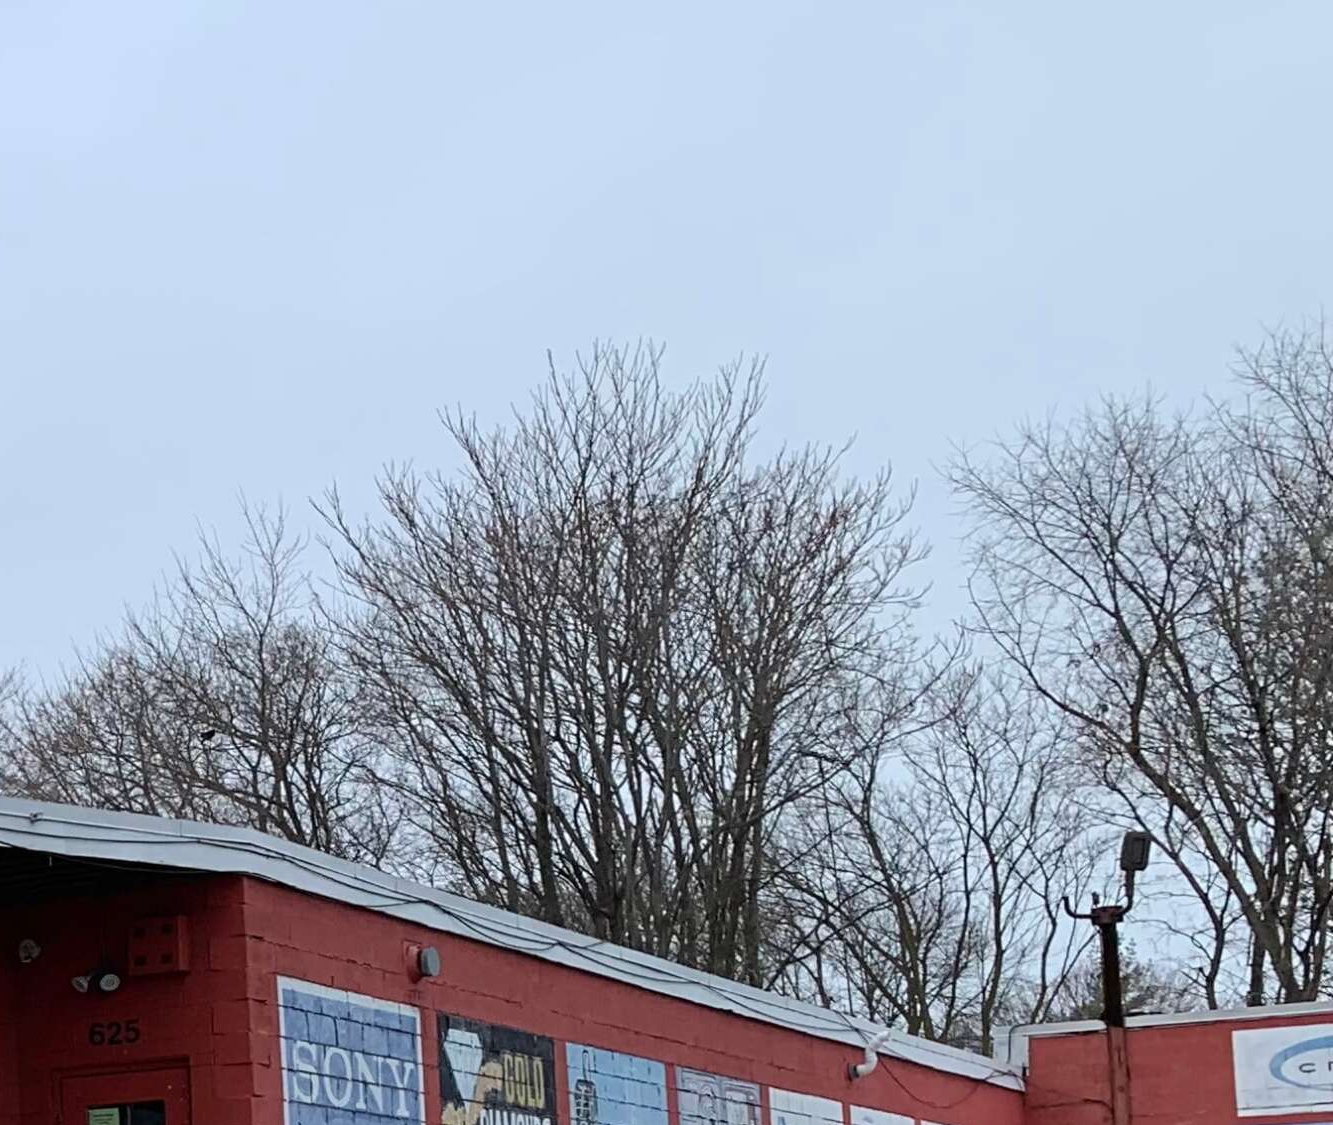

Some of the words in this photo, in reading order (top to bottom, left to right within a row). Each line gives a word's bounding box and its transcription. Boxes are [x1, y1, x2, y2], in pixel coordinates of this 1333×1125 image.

[88, 1019, 141, 1046] 625
[290, 1039, 416, 1118] SONY
[500, 1051, 545, 1109] GOLD
